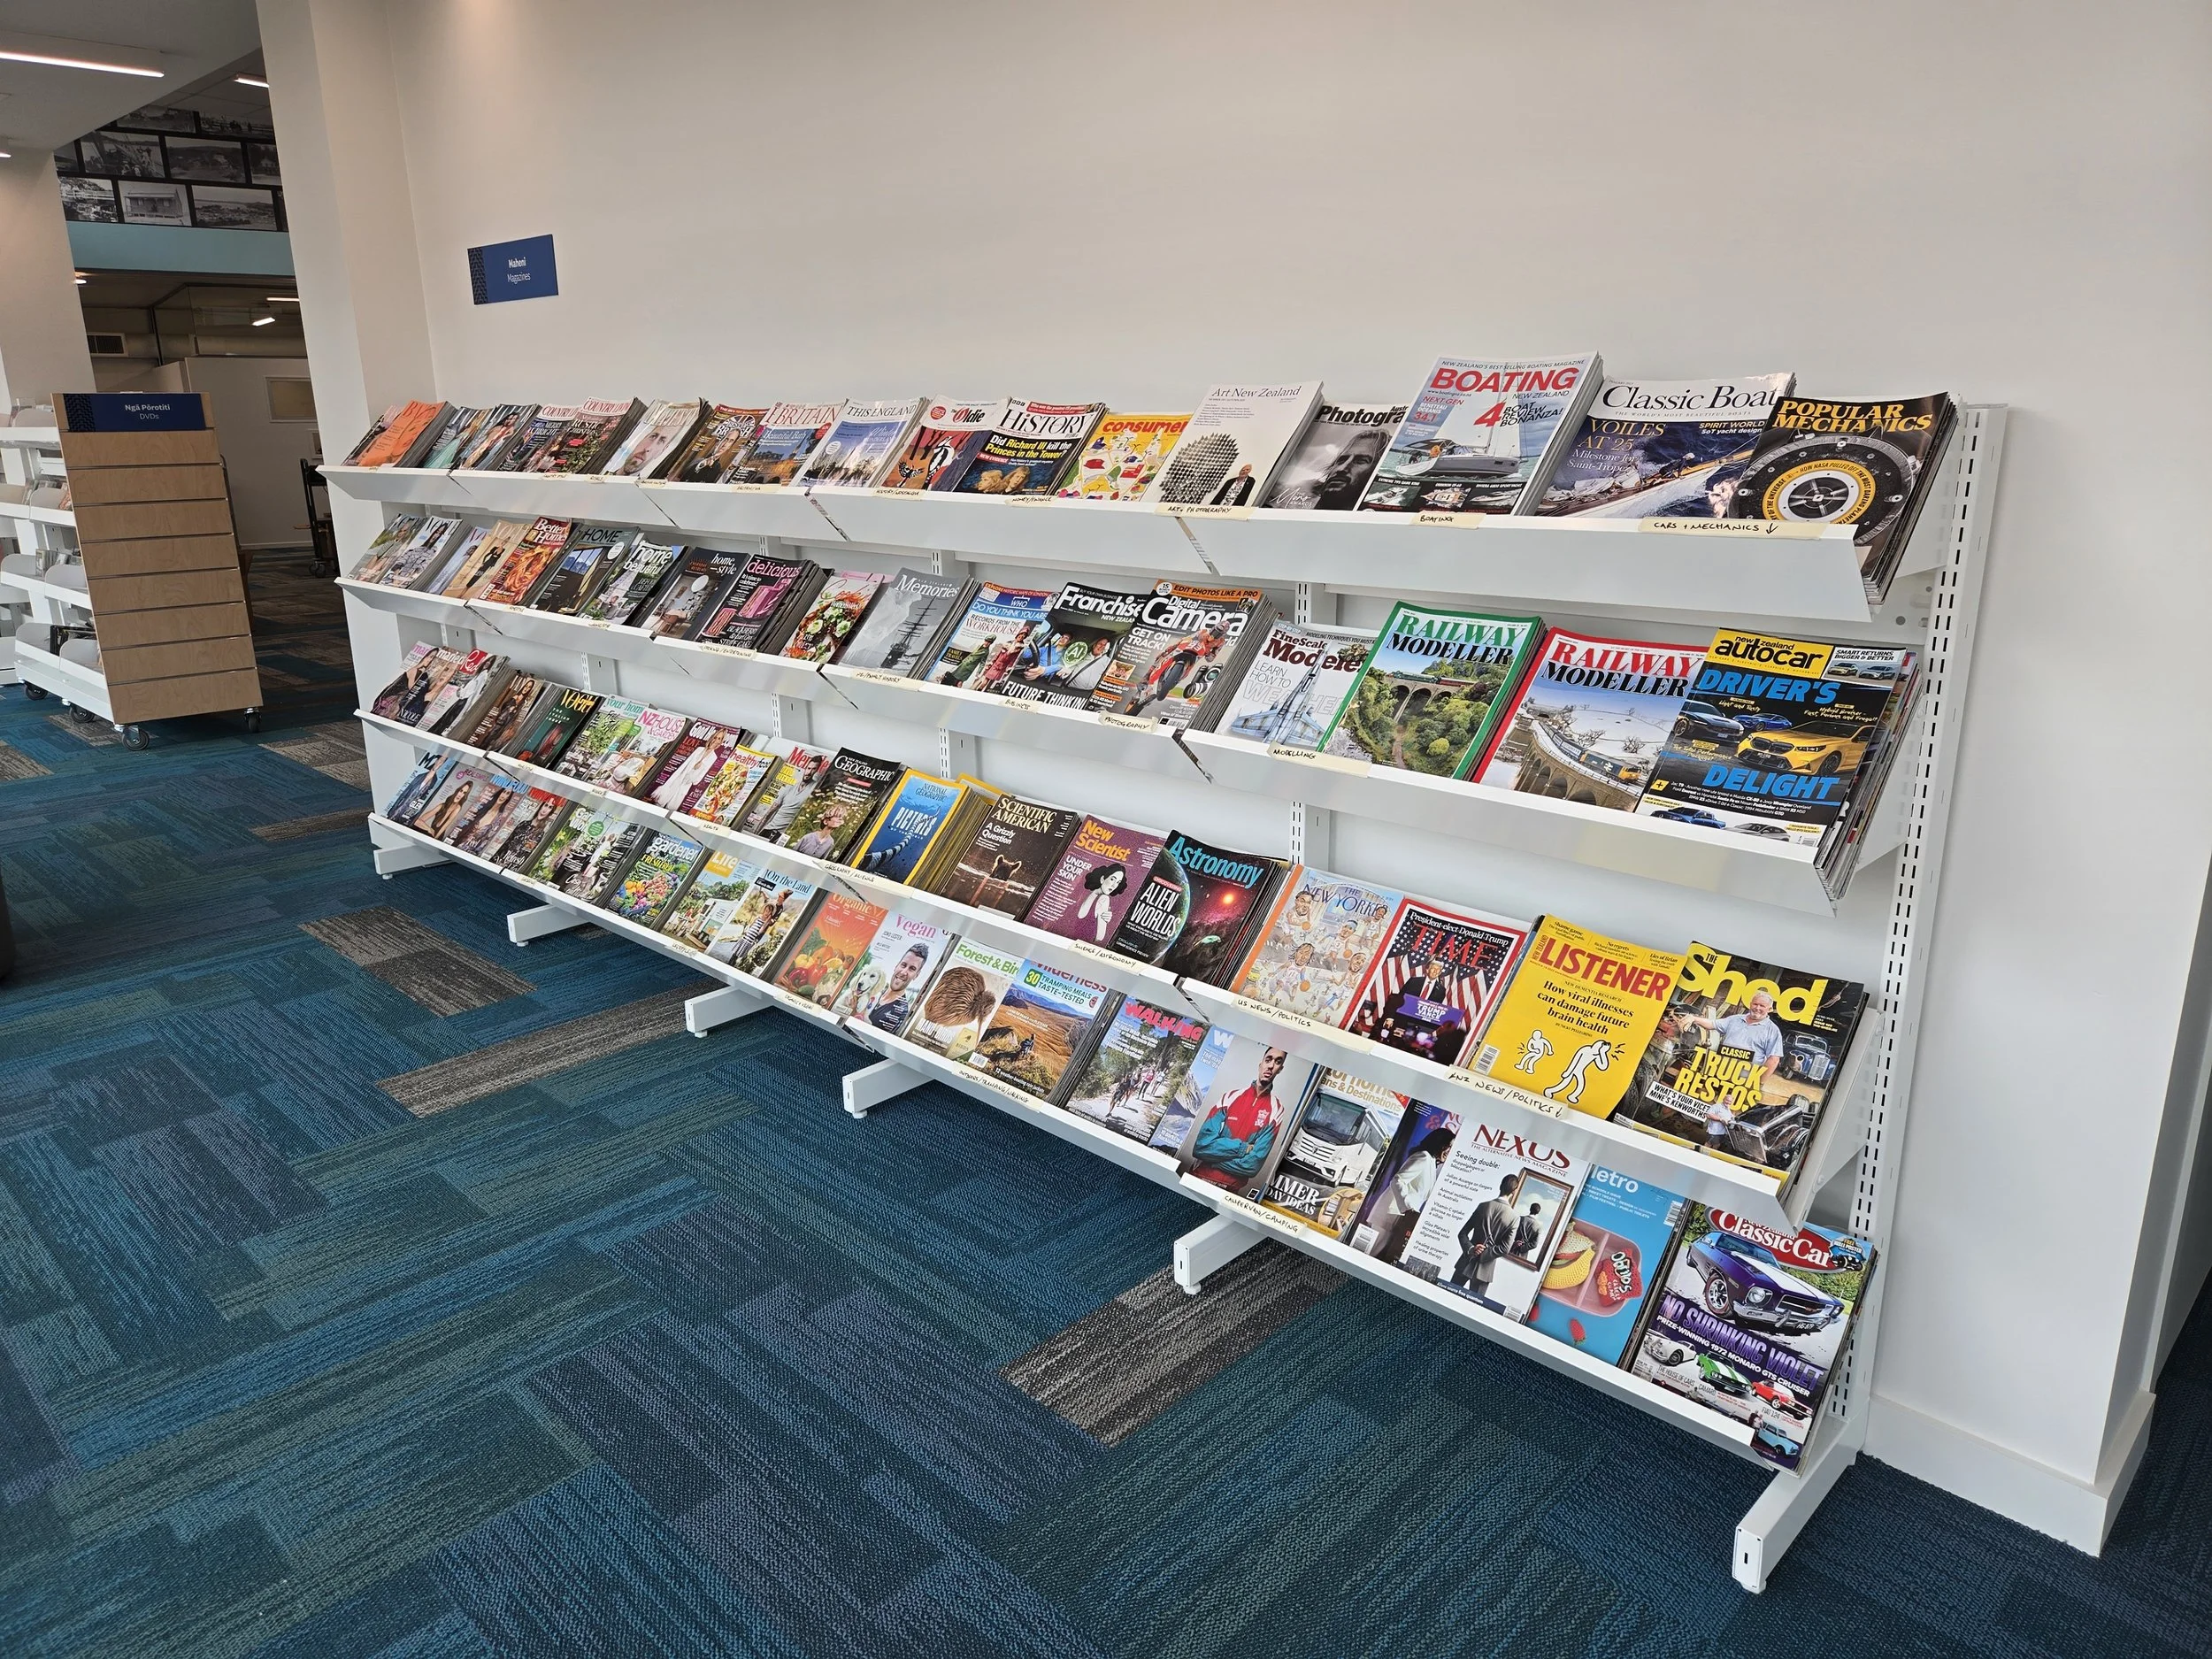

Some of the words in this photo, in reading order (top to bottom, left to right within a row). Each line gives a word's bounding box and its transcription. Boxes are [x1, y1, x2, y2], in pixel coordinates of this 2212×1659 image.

[508, 257, 526, 268] Maheni
[507, 272, 531, 285] Magazines
[1430, 367, 1579, 393] BOATING
[1211, 387, 1230, 398] Art
[1232, 388, 1256, 398] New
[1257, 385, 1302, 398] Zealand
[1602, 384, 1705, 411] Classic
[1707, 385, 1779, 408] Boat
[142, 403, 171, 412] Pōrotiti
[846, 404, 869, 418] THIS
[870, 403, 916, 419] ENGLAND
[952, 407, 986, 424] Oldie
[1473, 400, 1506, 427] 4
[1499, 408, 1564, 427] BONANZA!
[1501, 404, 1547, 420] REVIEW
[1503, 401, 1536, 414] BOAT
[1778, 400, 1904, 419] POPULAR
[1102, 419, 1188, 434] consumer
[1591, 420, 1666, 438] VOILES
[1772, 413, 1932, 434] MECHANICS
[985, 442, 1017, 457] Princes
[1025, 449, 1039, 458] the
[1040, 449, 1067, 459] Tower?
[534, 518, 566, 532] Better
[1419, 514, 1455, 523] BOATING
[1690, 523, 1760, 533] MECHANICS
[534, 530, 568, 544] Homes
[581, 530, 623, 543] HOME
[632, 545, 672, 565] home
[710, 553, 735, 566] home
[623, 557, 664, 574] beautiful
[746, 560, 802, 578] delicious
[895, 575, 960, 598] Memories
[1191, 587, 1220, 596] PHOTOS
[972, 601, 986, 611] DO
[986, 604, 1002, 615] YOU
[1001, 608, 1019, 618] THINK
[1019, 610, 1036, 618] YOU
[1054, 585, 1144, 618] Franchise
[1168, 595, 1201, 609] Digital
[1142, 596, 1248, 637] Camera
[1132, 627, 1155, 638] GET
[1154, 631, 1171, 641] ON
[1273, 629, 1328, 649] FineScale
[1395, 614, 1526, 649] RAILWAY
[1128, 634, 1166, 651] TRACK!
[1386, 632, 1515, 666] MODELLER
[1760, 641, 1795, 651] zealand
[1549, 641, 1703, 679] RAILWAY
[1715, 638, 1824, 670] autocar
[1254, 661, 1287, 676] LEARN
[1249, 671, 1272, 685] HOW
[1272, 675, 1292, 688] TO
[1540, 661, 1690, 699] MODELLER
[1698, 669, 1840, 705] DRIVER'S
[654, 714, 685, 733] HOUSE
[1273, 749, 1316, 759] MODELLING
[833, 755, 896, 782] GEOGRAPHIC
[1701, 765, 1841, 801] DELIGHT
[915, 787, 948, 803] GEOGRAPHIC
[997, 797, 1057, 823] SCIENTIFIC
[991, 809, 1051, 834] AMERICAN
[993, 825, 1017, 838] Grizzly
[1082, 820, 1115, 841] New
[981, 830, 1012, 845] Question
[1075, 833, 1132, 863] Scientist
[1062, 861, 1085, 876] YOUR
[1065, 854, 1093, 871] UNDER
[1168, 836, 1265, 889] Astronomy
[767, 872, 780, 881] On
[780, 877, 793, 887] the
[795, 882, 811, 894] Land
[1057, 869, 1078, 882] SKIN
[1140, 883, 1180, 912] ALIEN
[1303, 883, 1331, 905] NEW
[1343, 887, 1361, 896] THE
[831, 894, 871, 914] Organic
[895, 914, 936, 938] Vegan
[1129, 902, 1181, 937] WORLDS
[1409, 910, 1458, 934] President-elect
[1458, 926, 1485, 940] Donald
[1484, 933, 1509, 946] Trump
[1411, 921, 1499, 970] TIME
[956, 945, 991, 965] Forest
[991, 959, 1000, 969] &
[1706, 953, 1717, 964] THE
[1539, 937, 1671, 1002] LISTENER
[1026, 970, 1041, 985] 30
[1041, 974, 1073, 995] TRAMPING
[1073, 987, 1092, 1000] MEALS
[1038, 980, 1085, 1005] TASTE-TESTED
[1677, 942, 1828, 1026] Shed
[1543, 980, 1566, 995] How
[1568, 990, 1592, 1005] viral
[1592, 997, 1634, 1018] illnesses
[1417, 1002, 1447, 1017] TRUMP
[1537, 991, 1555, 1004] can
[1555, 997, 1596, 1018] damage
[1597, 1012, 1630, 1029] future
[1125, 1002, 1204, 1041] WALKING
[1547, 1007, 1574, 1023] brain
[1575, 1016, 1609, 1035] health
[1720, 1046, 1751, 1060] CLASSIC
[1690, 1046, 1769, 1092] TRUCK
[1346, 1083, 1402, 1112] Destinations
[1654, 1084, 1678, 1100] WHAT'S
[1678, 1094, 1694, 1106] YOUR
[1693, 1100, 1711, 1111] VICE?
[1673, 1068, 1763, 1112] RESTOS
[1648, 1090, 1671, 1107] MINE'S
[1671, 1098, 1708, 1120] KENWORTHS
[1473, 1124, 1571, 1170] NEXUS
[1455, 1150, 1479, 1165] Seeing
[1478, 1157, 1501, 1170] double:
[1718, 1212, 1792, 1253] Classic
[1793, 1238, 1832, 1268] Car
[1659, 1294, 1686, 1322] NO
[1682, 1307, 1768, 1363] SHRINKING
[1765, 1346, 1824, 1392] VIOLET
[1656, 1315, 1710, 1348] PRIZE-WINNING
[1710, 1342, 1727, 1356] 1972
[1727, 1351, 1762, 1373] MONARO
[1762, 1369, 1778, 1381] GTS
[1777, 1376, 1811, 1398] CRUISER
